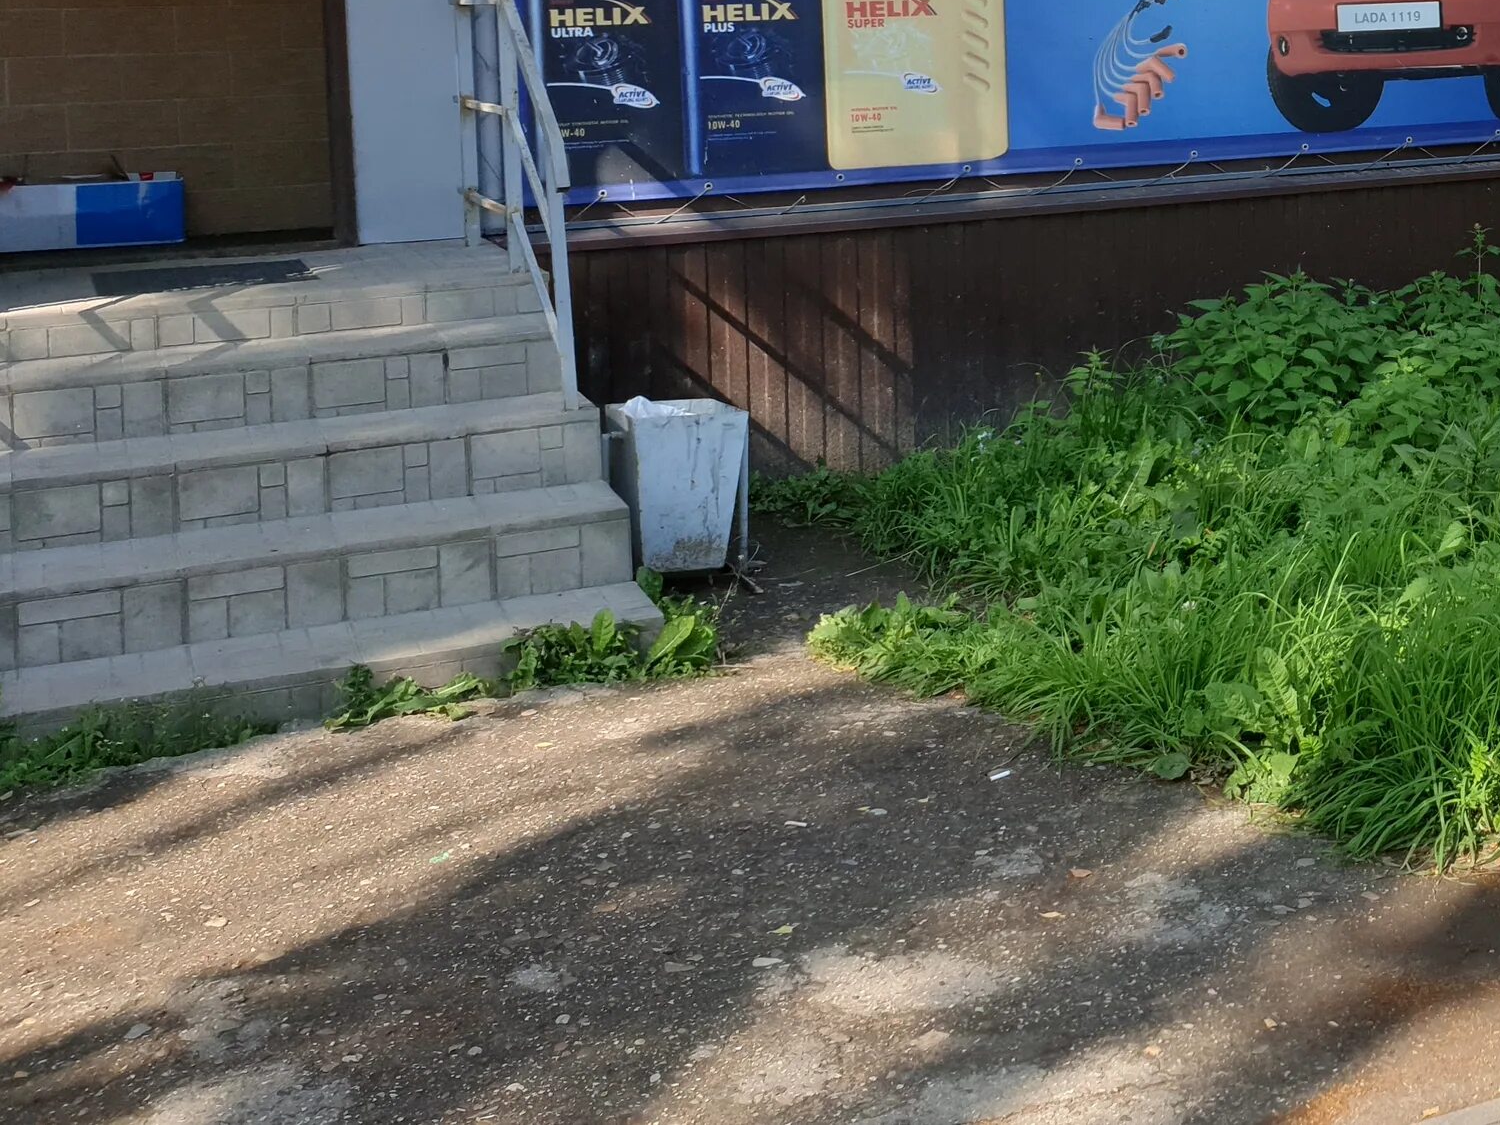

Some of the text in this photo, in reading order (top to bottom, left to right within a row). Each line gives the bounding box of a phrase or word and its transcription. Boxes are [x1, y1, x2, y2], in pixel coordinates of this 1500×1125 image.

[549, 5, 651, 27] HELIX
[702, 1, 797, 23] HELIX
[1354, 10, 1421, 24] LADA 1119
[703, 22, 735, 33] PLUS
[847, 18, 885, 29] SUPER
[551, 26, 594, 38] ULTRA
[850, 113, 881, 123] 10W-40
[707, 120, 741, 130] 10W-40
[560, 127, 585, 138] W-40
